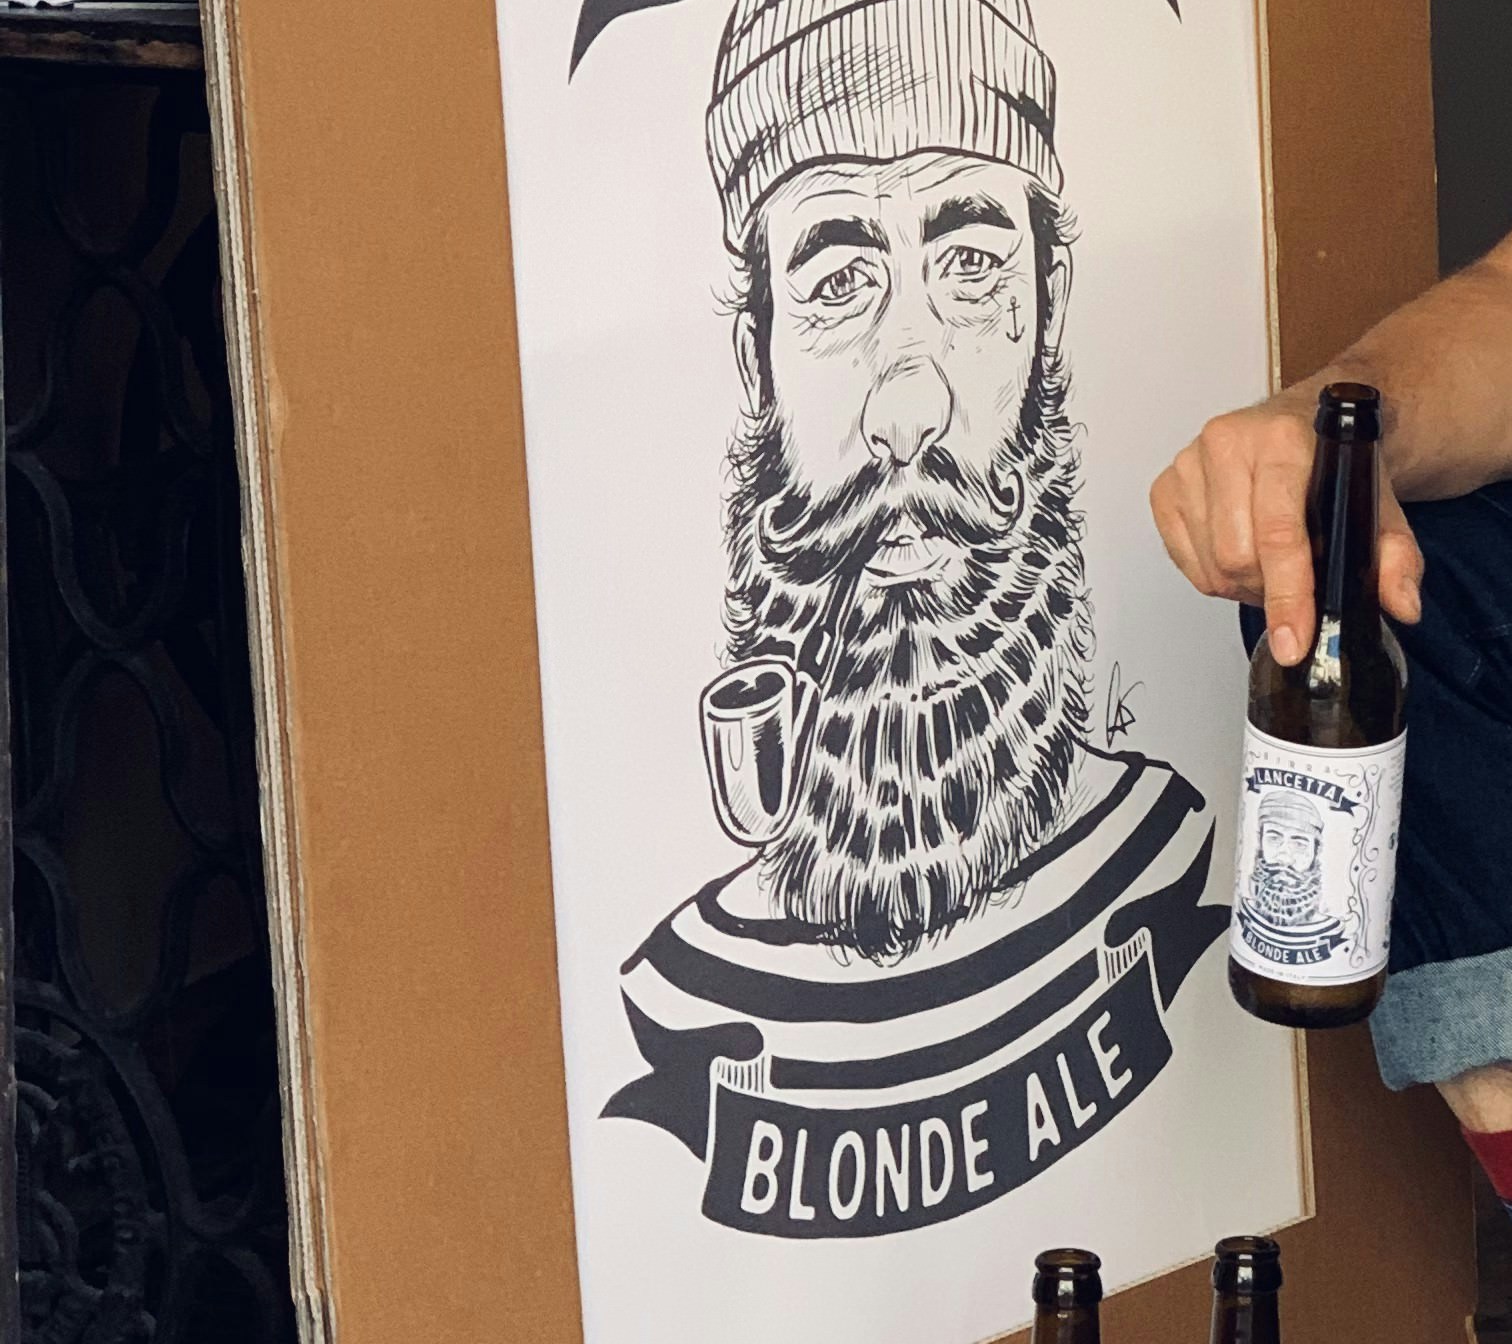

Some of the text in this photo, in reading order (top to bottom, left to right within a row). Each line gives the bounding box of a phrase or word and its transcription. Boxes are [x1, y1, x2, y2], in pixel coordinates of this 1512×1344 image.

[1256, 768, 1337, 801] LANCETTA
[1245, 931, 1323, 964] BLONDE ALE
[739, 1009, 1135, 1222] BLONDE ALE
